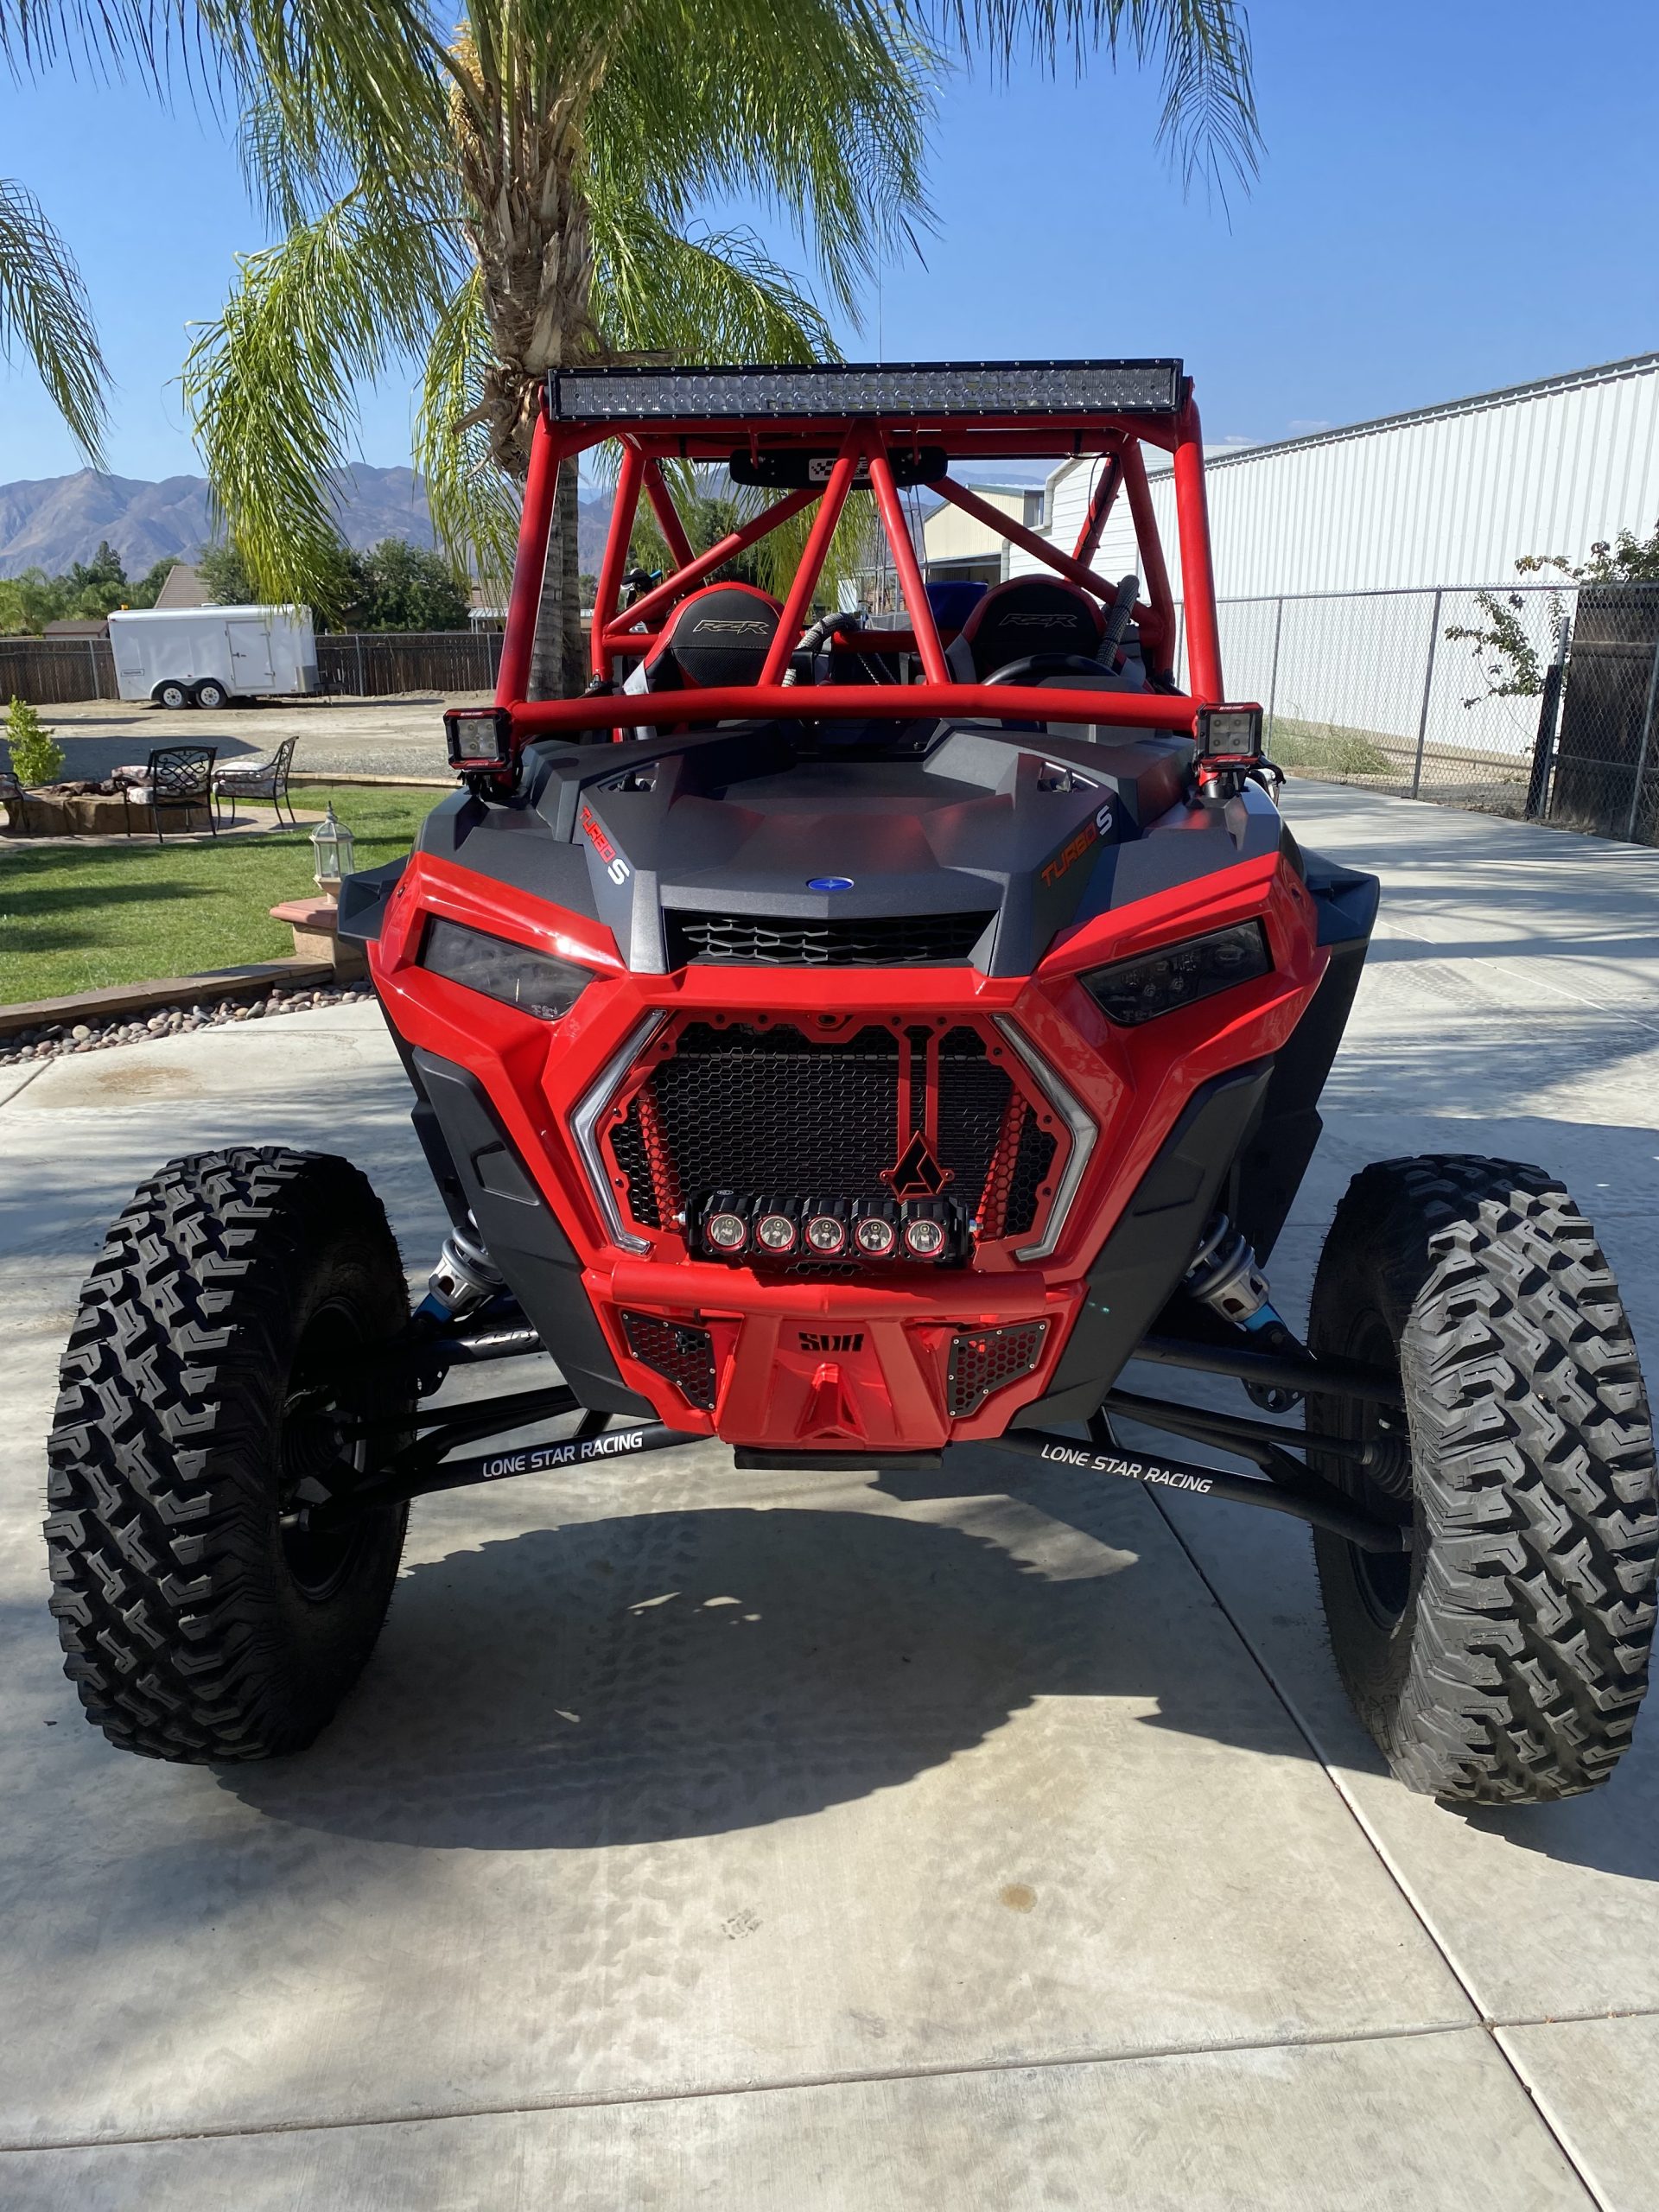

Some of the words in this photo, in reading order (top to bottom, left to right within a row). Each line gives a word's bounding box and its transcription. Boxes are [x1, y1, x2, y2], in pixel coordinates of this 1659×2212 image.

[693, 620, 769, 635] RZR
[579, 804, 616, 864] TURBO
[607, 858, 630, 885] S
[1041, 821, 1098, 887] TURBO
[1096, 804, 1113, 836] S
[482, 1455, 525, 1478] LONE
[531, 1445, 575, 1468] STAR
[581, 1431, 643, 1459] RACING
[1040, 1443, 1090, 1466] LONE
[1090, 1455, 1142, 1478] STAR
[1143, 1467, 1213, 1493] RACING
